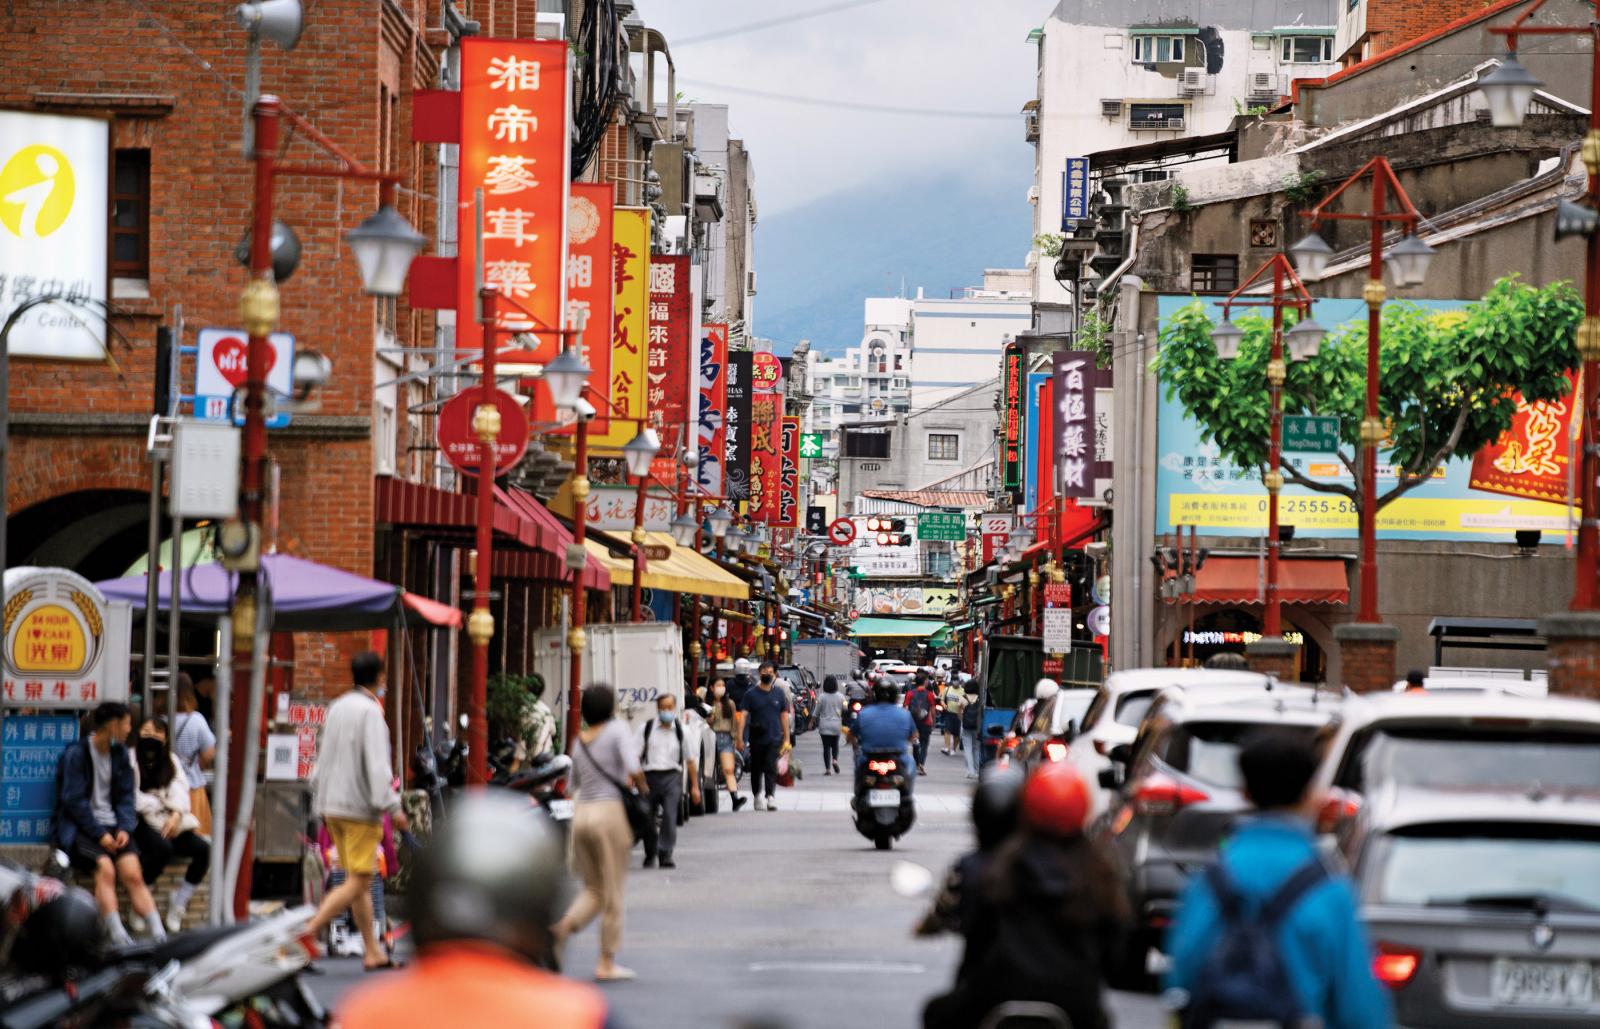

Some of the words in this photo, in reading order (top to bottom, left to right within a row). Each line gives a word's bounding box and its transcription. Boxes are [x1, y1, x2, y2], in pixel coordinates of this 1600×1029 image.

[1288, 421, 1334, 435] 永昌街
[801, 435, 820, 457] 茶
[1258, 500, 1358, 513] 0-2555-58
[618, 687, 658, 702] 7302
[3, 766, 56, 778] EXCHAN
